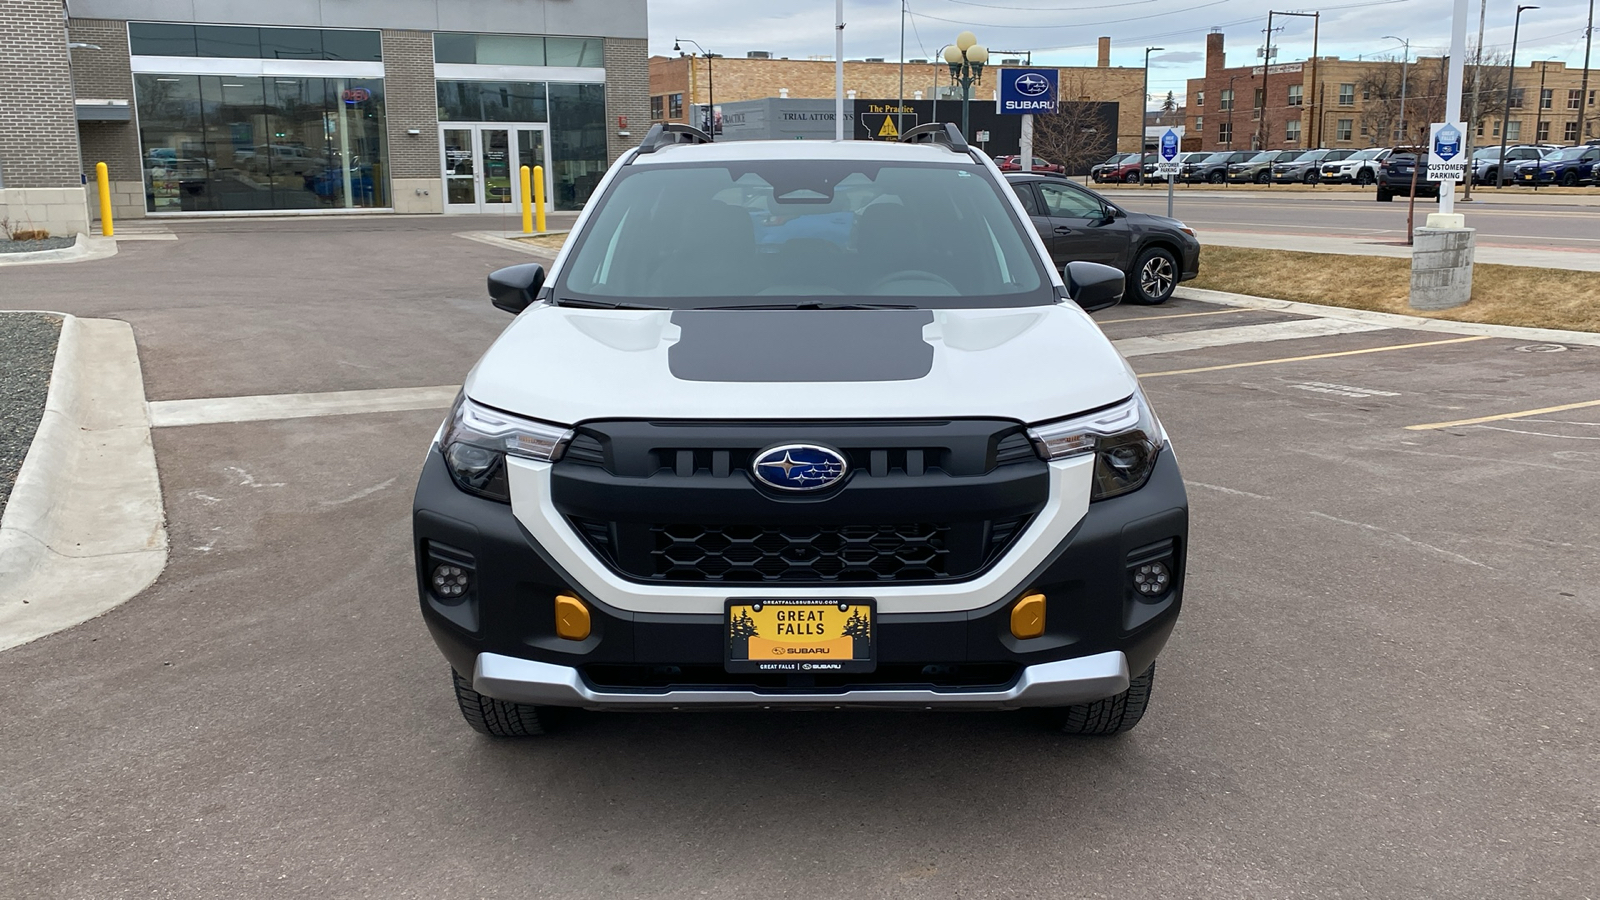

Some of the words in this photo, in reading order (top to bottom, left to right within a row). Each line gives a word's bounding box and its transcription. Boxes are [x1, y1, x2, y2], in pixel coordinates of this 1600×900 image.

[342, 89, 369, 101] OPEN
[868, 104, 883, 113] The
[885, 104, 914, 113] Pratice
[1005, 101, 1054, 109] SUBARU
[783, 113, 807, 121] TRIAL
[809, 113, 854, 121] ATTORYS
[777, 611, 825, 621] GREAT
[777, 623, 825, 635] FALLS
